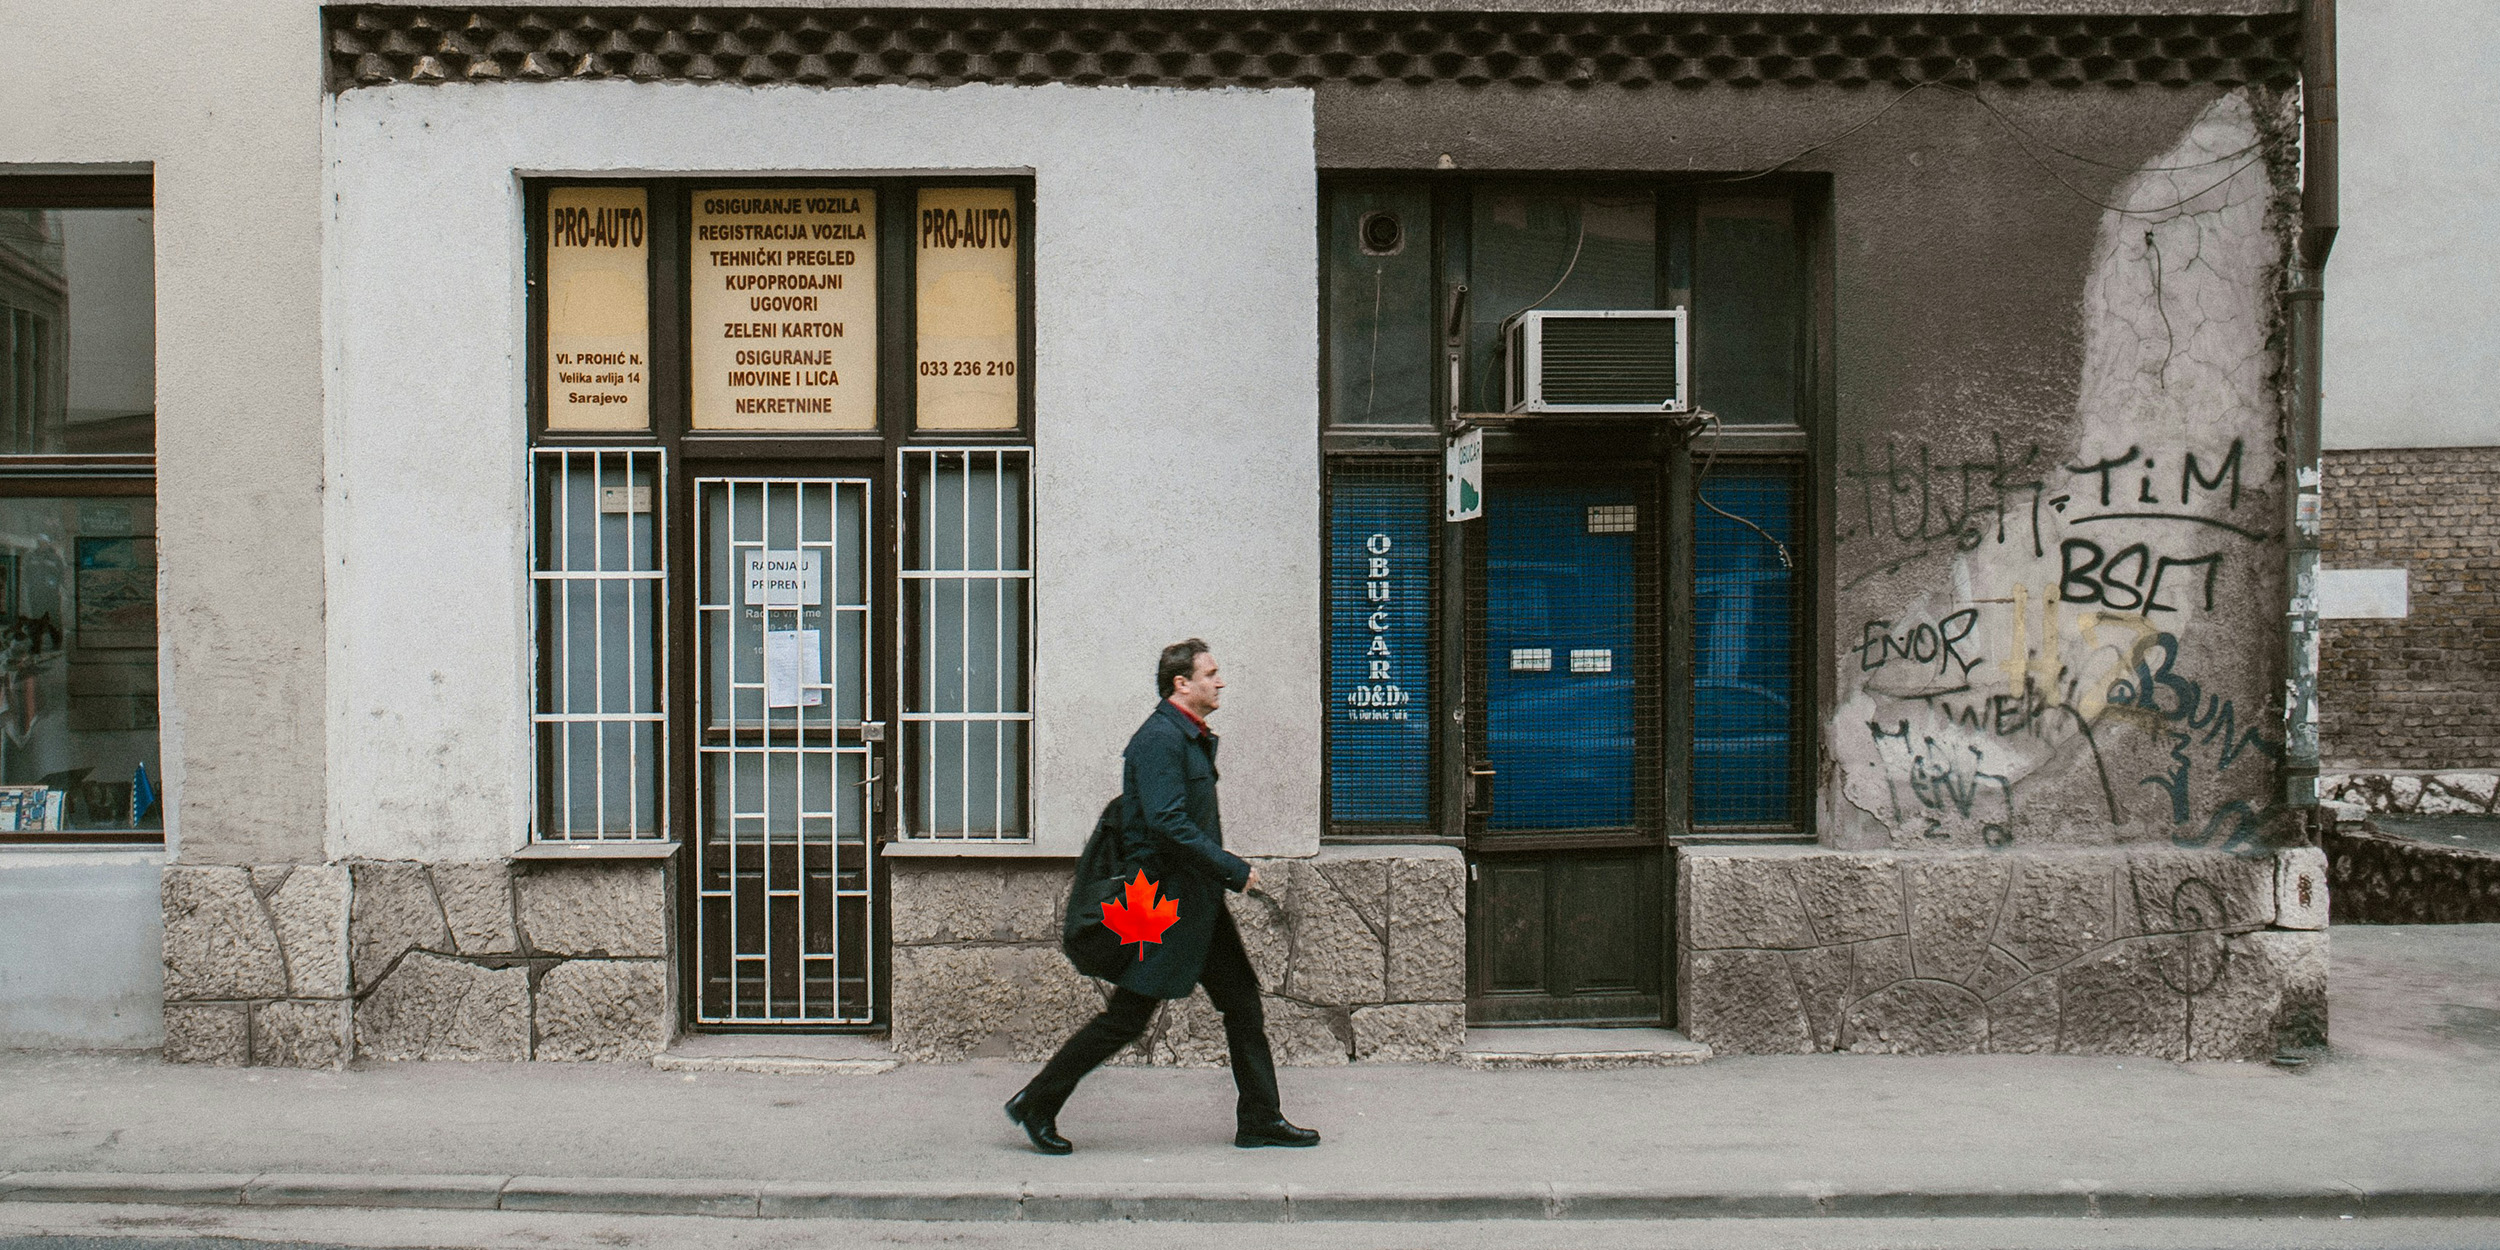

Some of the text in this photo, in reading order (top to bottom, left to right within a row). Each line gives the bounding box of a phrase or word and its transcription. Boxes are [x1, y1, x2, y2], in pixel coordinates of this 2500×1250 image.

[704, 198, 861, 215] OSIGURANJE VOZILA
[554, 206, 644, 248] PRO-AUTO
[699, 224, 866, 241] REGISTRACIJA VOZILA
[922, 208, 1012, 249] PRO-AUTO
[710, 247, 855, 267] TEHNIČKI PREGLED
[725, 274, 843, 291] KUPOPRODAJNI
[750, 296, 818, 312] UGOVORI
[724, 322, 844, 339] ZELENI KARTON
[576, 351, 626, 365] PROHIĆ
[629, 354, 643, 365] N.
[735, 349, 832, 366] OSIGURANJE
[919, 361, 1015, 377] 033 236 210
[558, 372, 640, 386] Velika avlija 14
[728, 371, 839, 387] IMOVINE I LICA
[568, 392, 628, 406] Sarajevo
[735, 397, 832, 414] NEKRETNINE
[752, 561, 797, 571] RADNJA
[1366, 533, 1392, 680] OBUĆAR
